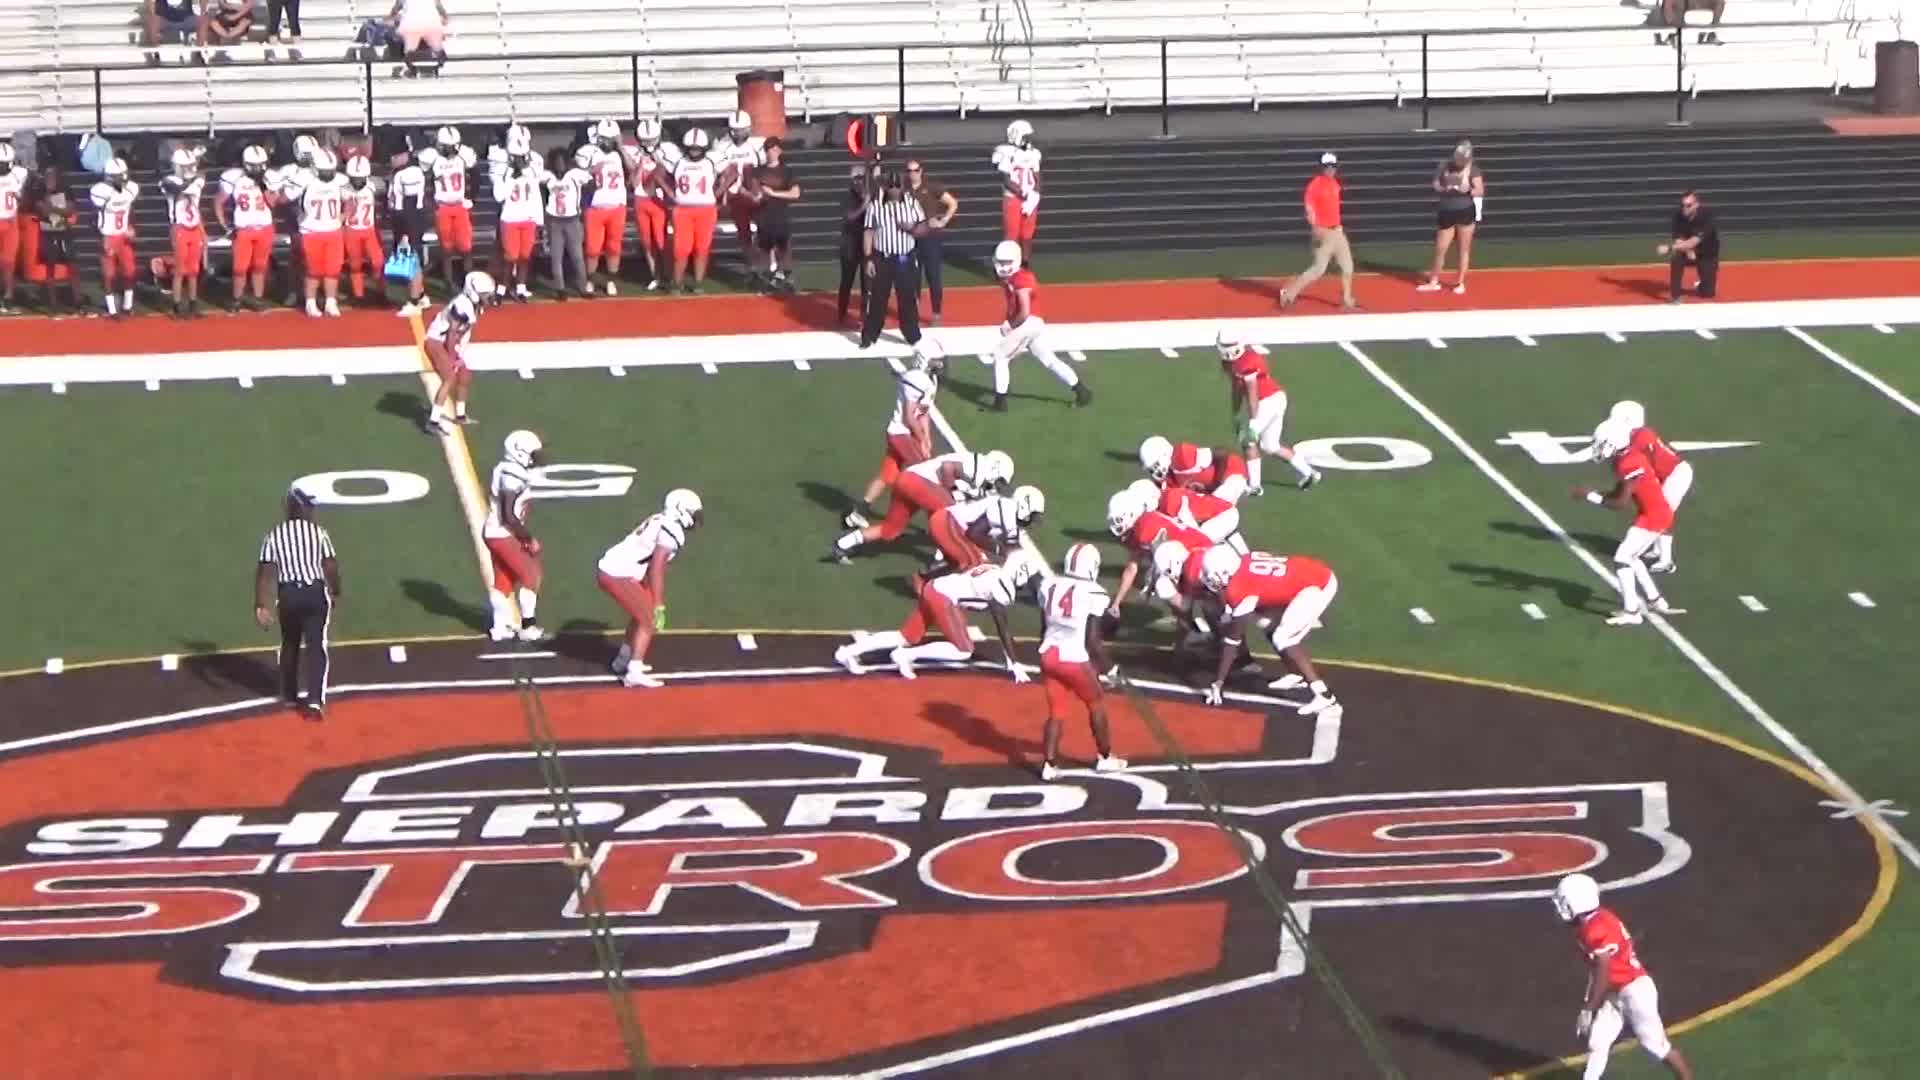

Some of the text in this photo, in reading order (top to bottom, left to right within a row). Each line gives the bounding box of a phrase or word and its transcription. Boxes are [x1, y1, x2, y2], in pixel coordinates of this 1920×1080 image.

[873, 114, 888, 147] 1
[1044, 583, 1077, 618] 14
[26, 785, 1087, 854] SHEPARD
